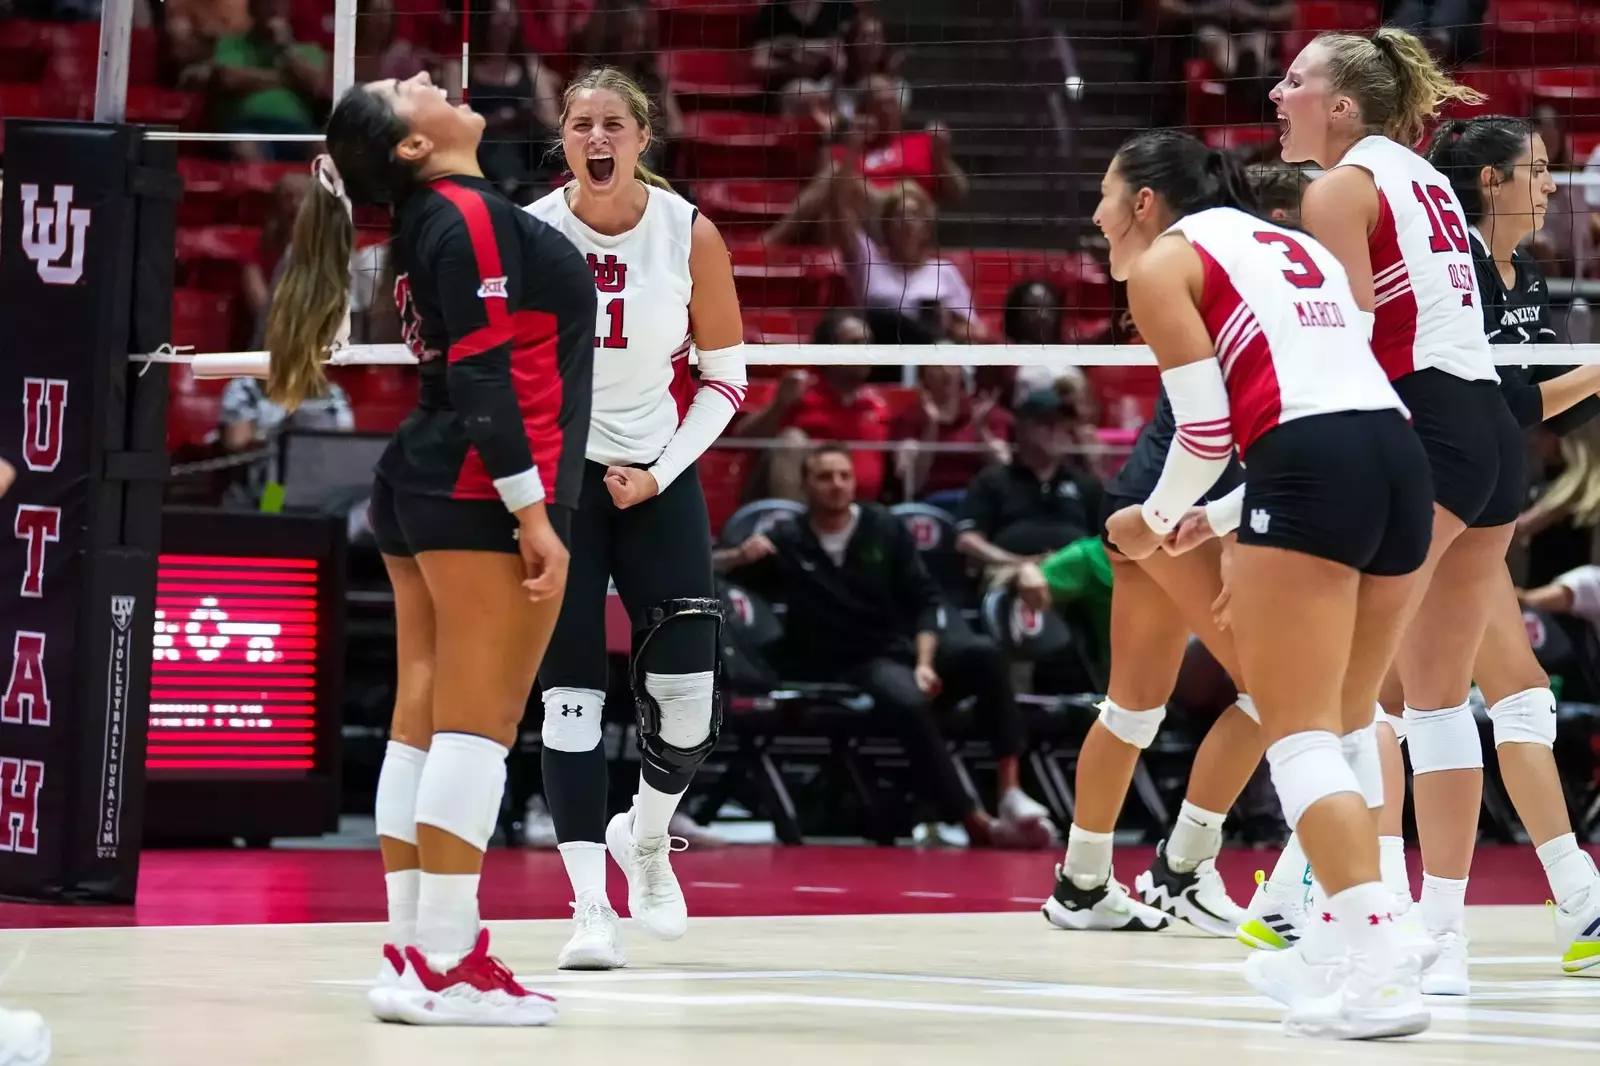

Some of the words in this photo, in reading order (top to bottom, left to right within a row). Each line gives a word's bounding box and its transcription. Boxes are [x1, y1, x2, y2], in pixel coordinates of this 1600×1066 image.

[1411, 180, 1470, 253] 16
[1252, 231, 1325, 289] 3
[0, 377, 69, 854] UTAH
